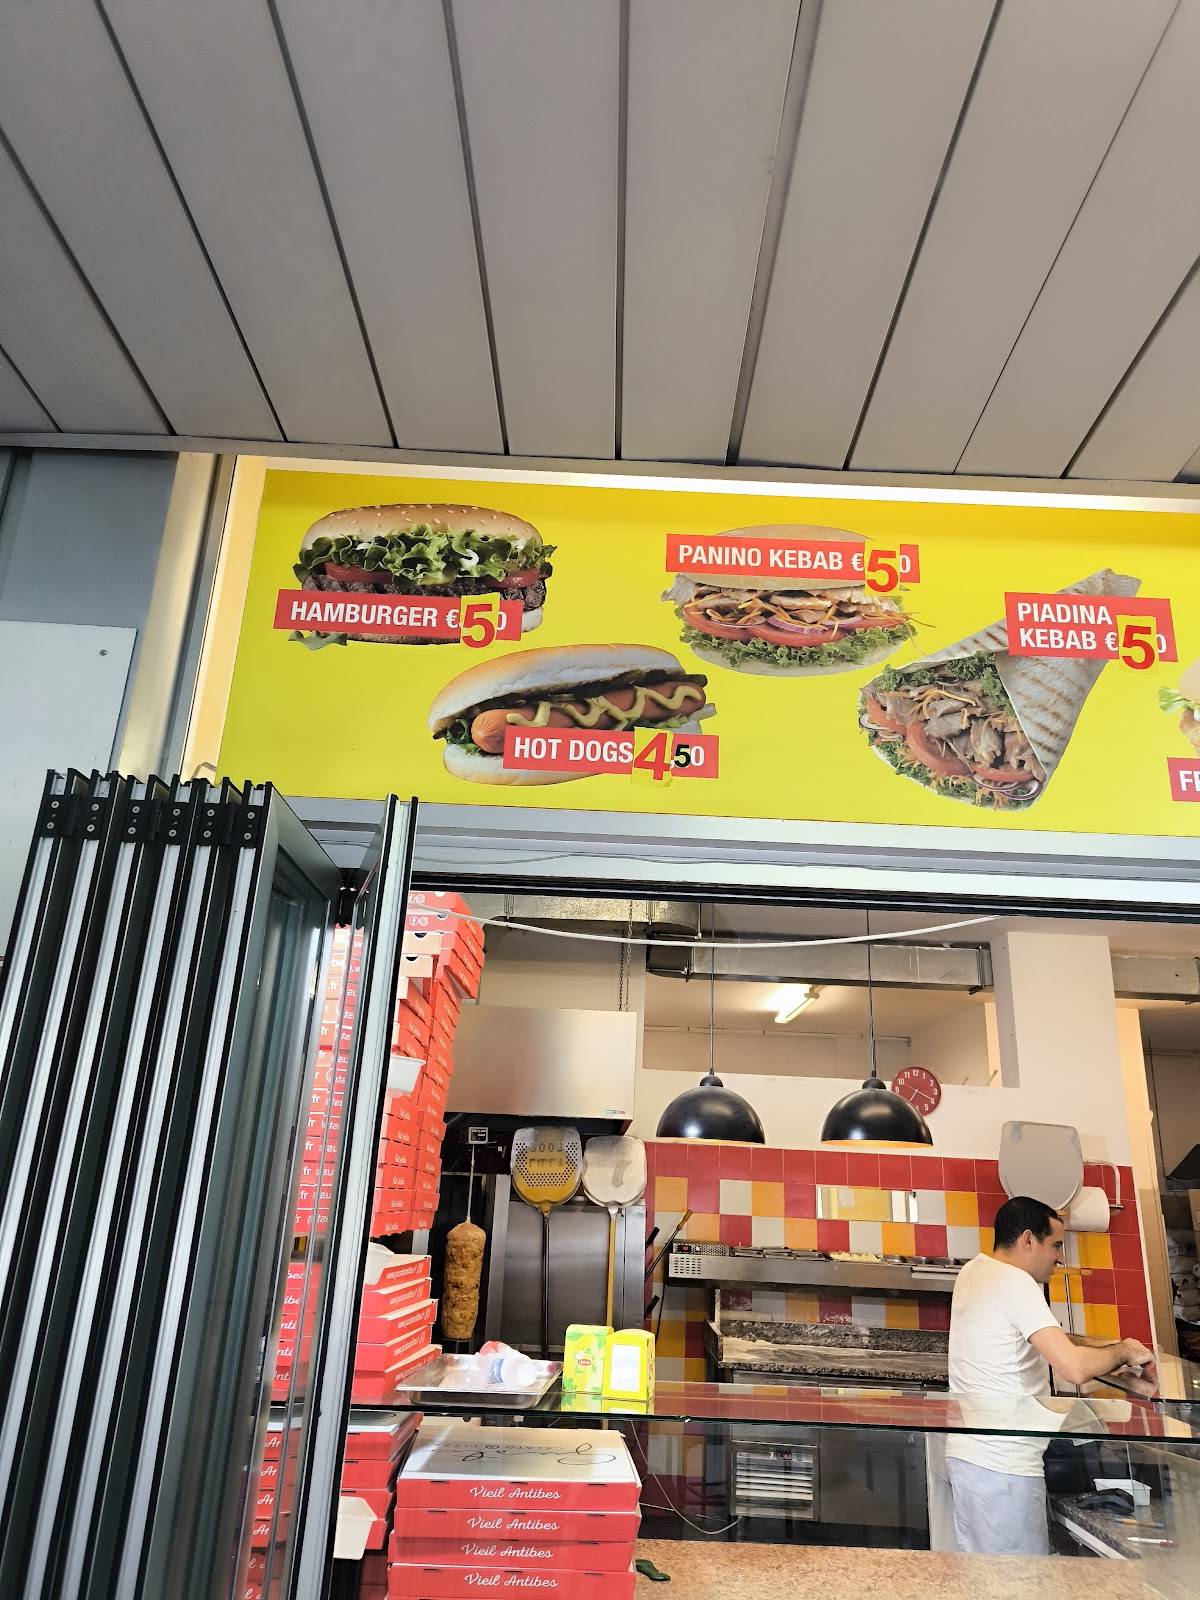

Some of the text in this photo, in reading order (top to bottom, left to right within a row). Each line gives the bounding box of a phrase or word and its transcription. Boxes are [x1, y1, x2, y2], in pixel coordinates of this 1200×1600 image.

[679, 544, 762, 567] PANINO
[769, 549, 843, 571] KEBAB
[290, 600, 438, 628] HAMBURGER
[1017, 602, 1112, 625] PIADINA
[1019, 627, 1098, 651] KEBAB
[514, 737, 562, 760] HOT
[568, 739, 634, 764] DOGS
[904, 1071, 910, 1079] 11
[912, 1069, 919, 1077] 12
[929, 1079, 934, 1087] 2
[933, 1088, 938, 1096] 3
[924, 1103, 929, 1111] 5
[469, 1486, 561, 1499] Vieil Antibes
[467, 1516, 560, 1530] Vieil Antibes
[461, 1543, 554, 1558] Vieil Antibes
[464, 1572, 559, 1588] Vieil Antibes
